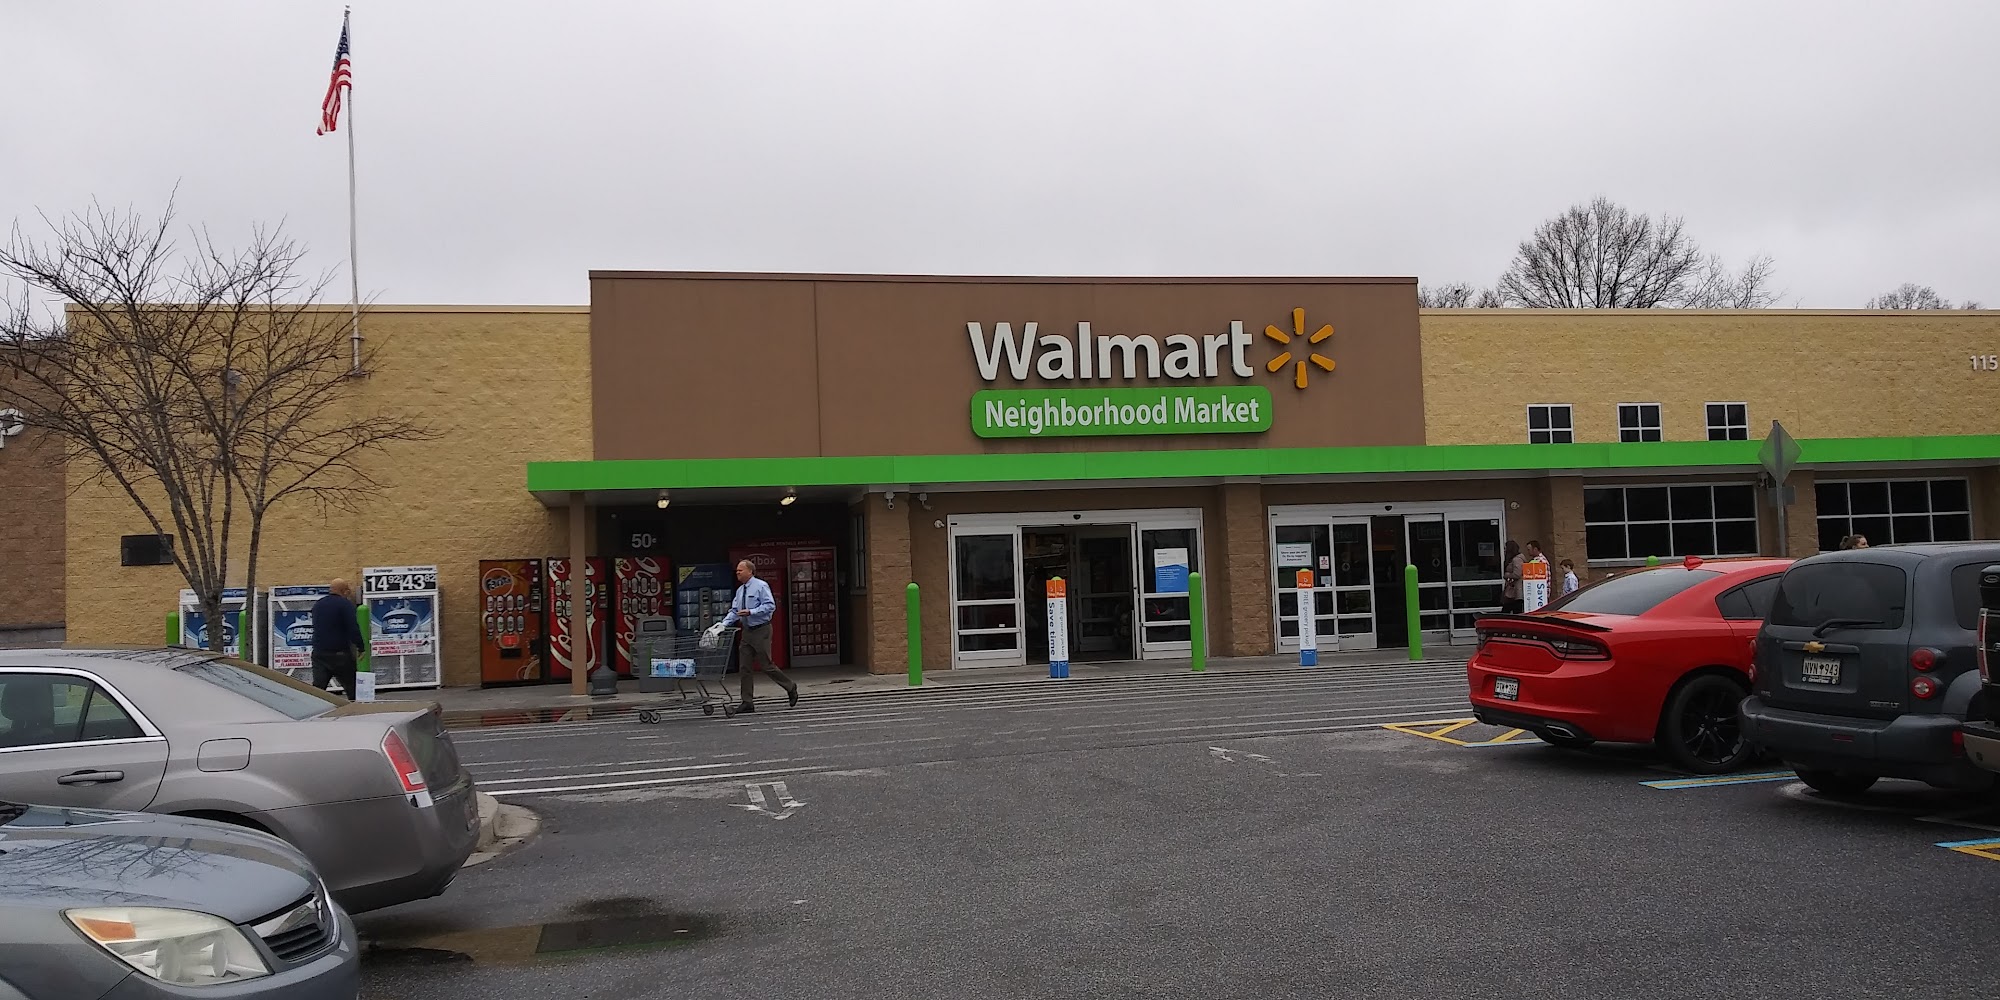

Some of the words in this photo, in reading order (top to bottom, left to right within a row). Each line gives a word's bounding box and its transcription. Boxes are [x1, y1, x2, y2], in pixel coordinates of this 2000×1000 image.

[966, 320, 1254, 381] Walmart
[985, 396, 1168, 435] Neighborhood
[1174, 395, 1260, 424] Market
[1536, 583, 1545, 607] Save
